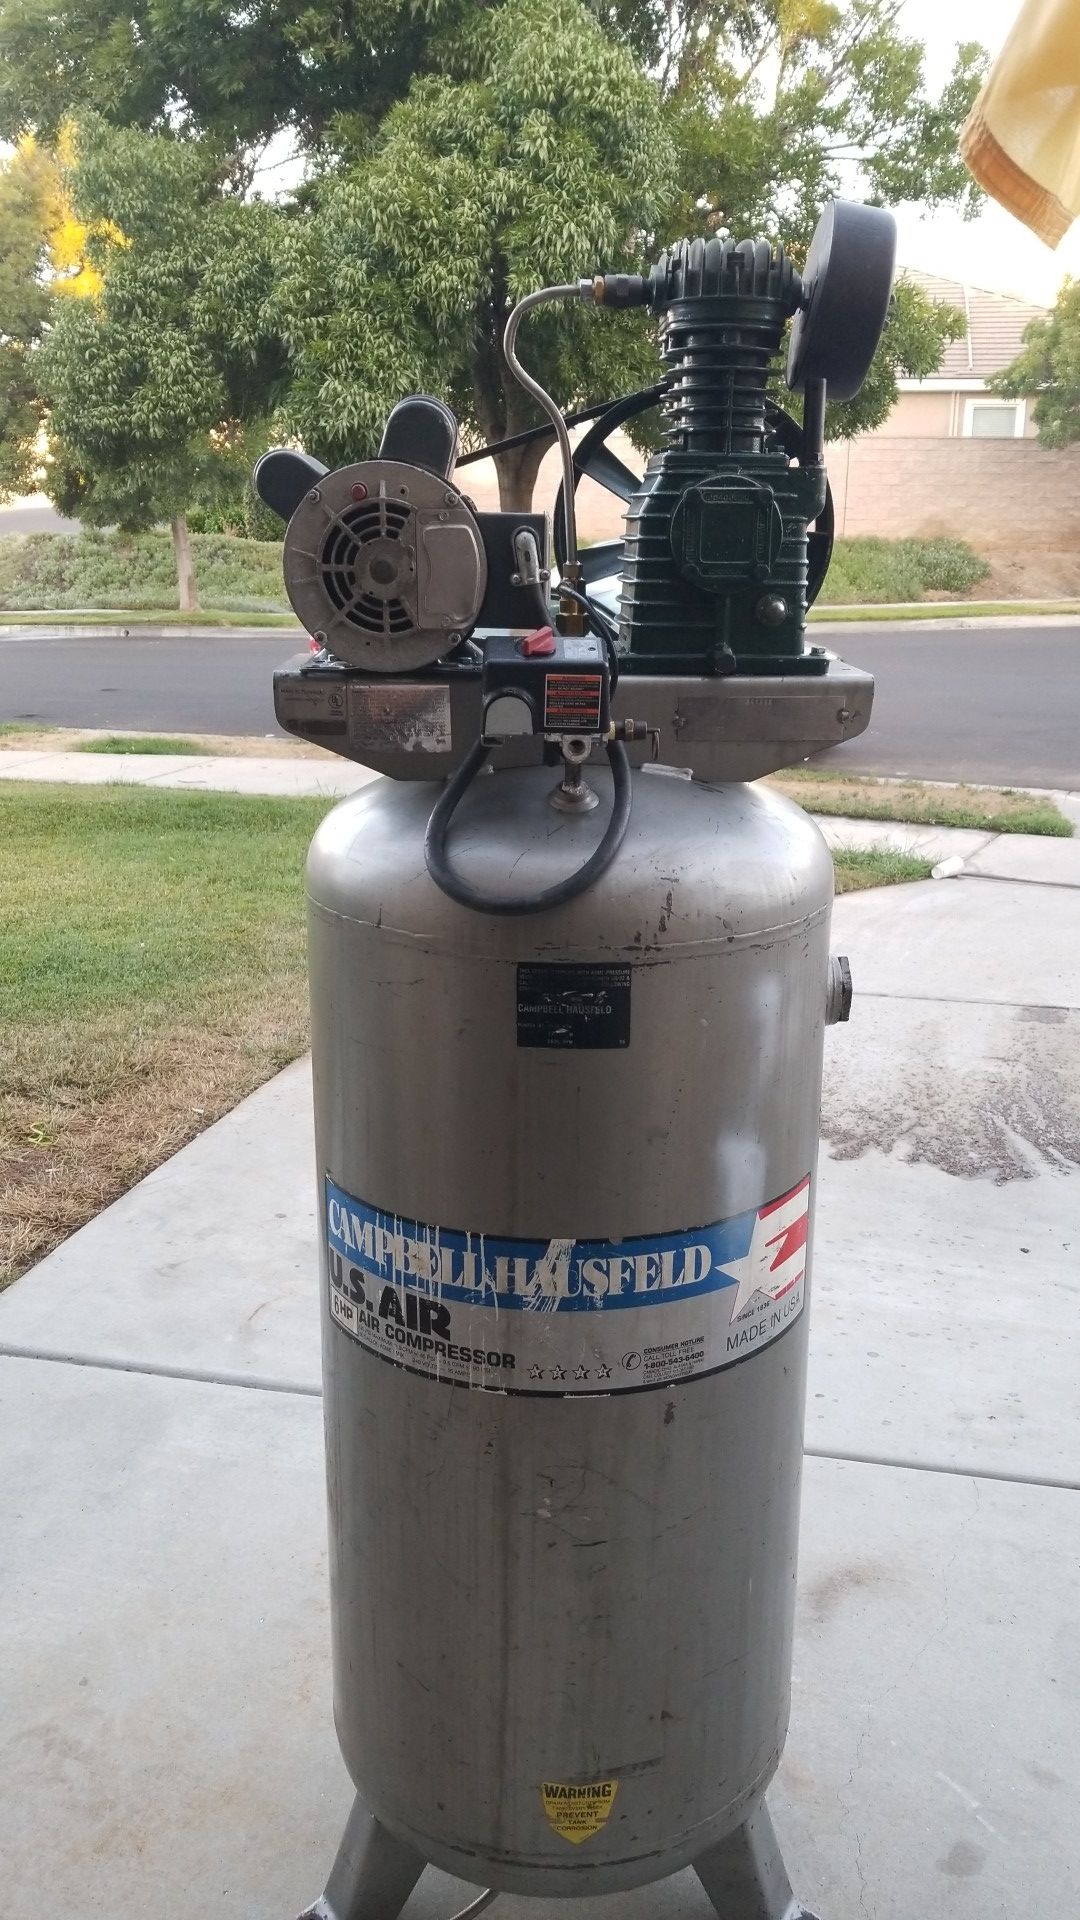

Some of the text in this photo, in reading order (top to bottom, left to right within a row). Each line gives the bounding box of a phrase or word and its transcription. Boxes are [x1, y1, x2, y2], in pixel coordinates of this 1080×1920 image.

[518, 1004, 563, 1013] CAMPBELL
[329, 1199, 712, 1298] CAMPBELL HAUSFELD
[726, 1290, 800, 1352] MADE IN USA
[359, 1309, 380, 1333] AIR
[385, 1323, 516, 1369] COMPRESSOR
[643, 1335, 705, 1354] CONSUMER HOTLINE
[643, 1346, 695, 1362] CALL TOLL FREE
[643, 1350, 705, 1370] 1-800-543-6400
[543, 1783, 612, 1799] WARNING
[556, 1811, 599, 1819] PREVENT
